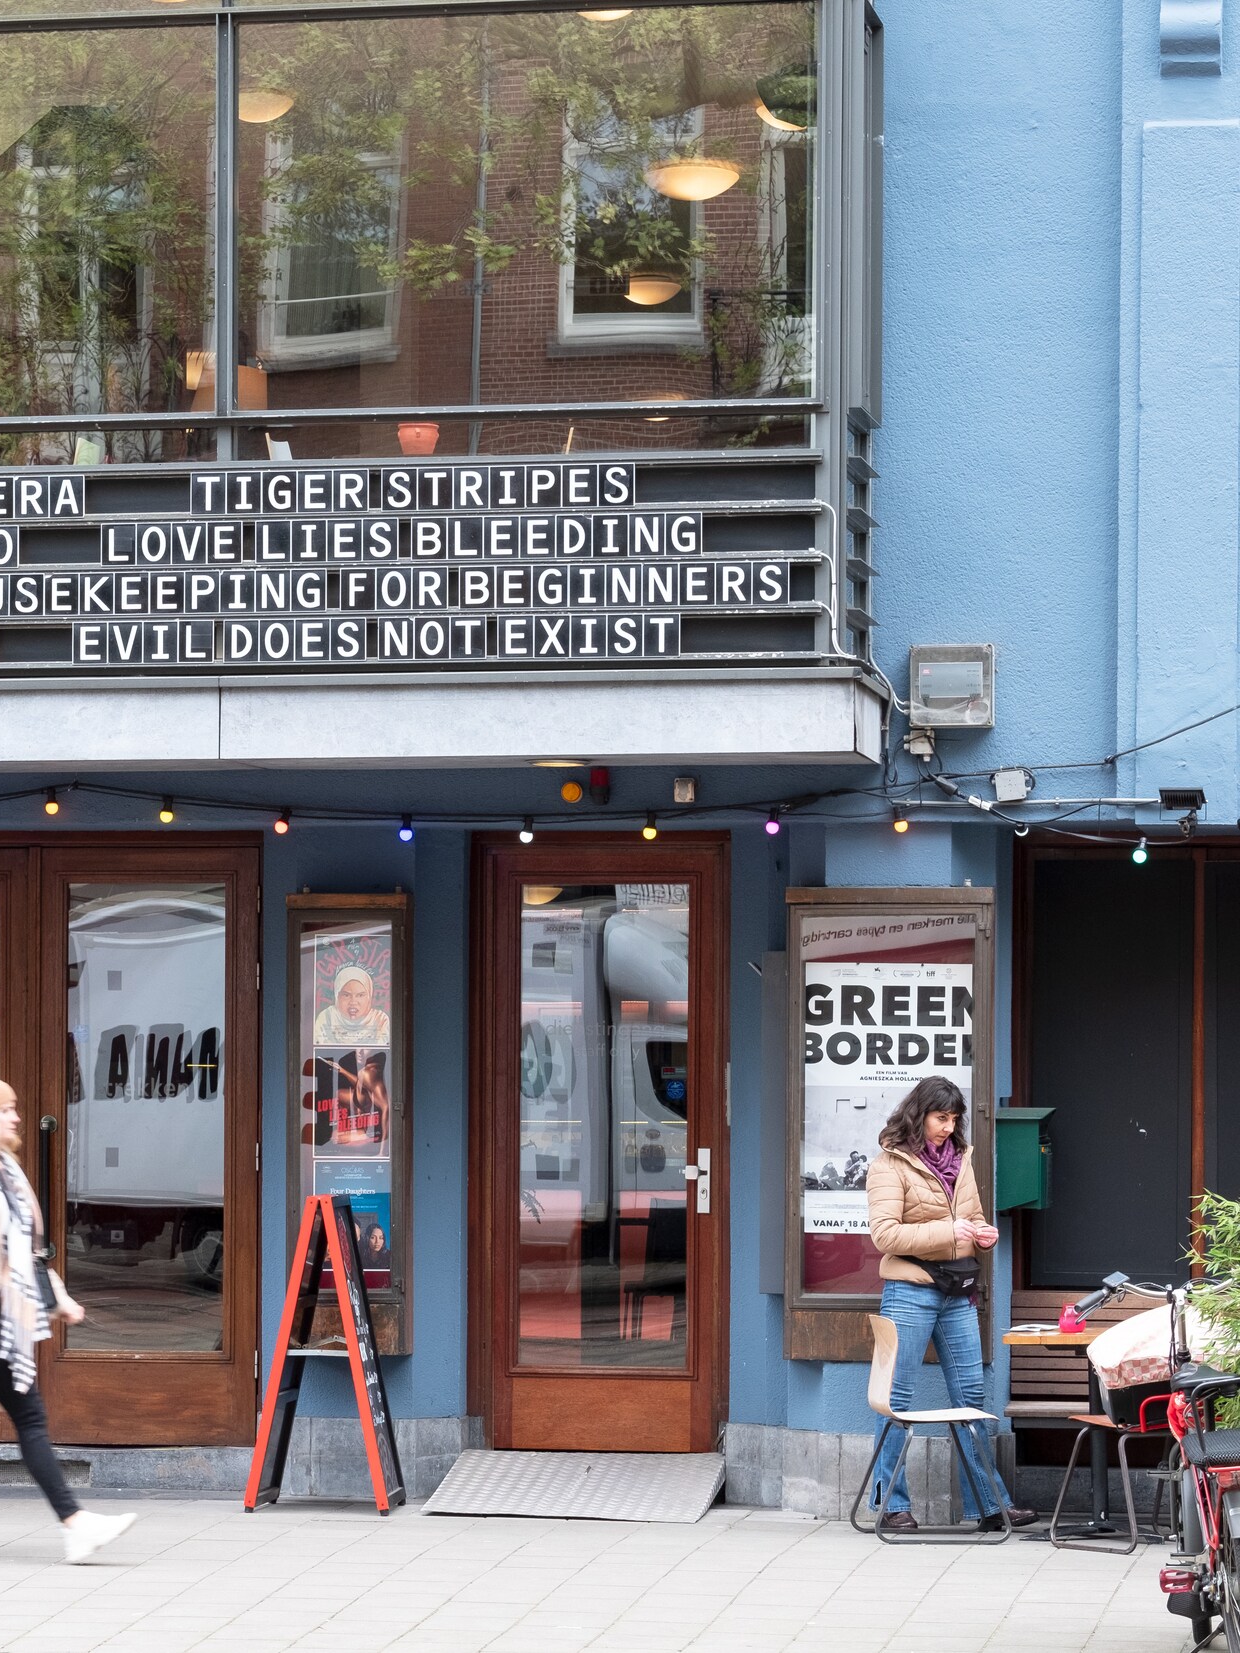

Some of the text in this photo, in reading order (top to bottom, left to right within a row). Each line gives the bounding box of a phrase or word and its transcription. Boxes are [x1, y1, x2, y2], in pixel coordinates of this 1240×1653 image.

[197, 466, 629, 511] TIGER STRIPES
[109, 516, 696, 562] LOVE LIES BLEEDING
[350, 570, 442, 608] FOR
[466, 564, 783, 605] BEGINNERS
[80, 616, 675, 661] EVIL DOES NOT EXIST
[317, 1098, 339, 1112] LOVE
[329, 1108, 348, 1121] LIES
[338, 1114, 379, 1132] BLEEDING
[345, 1187, 375, 1196] Daughters
